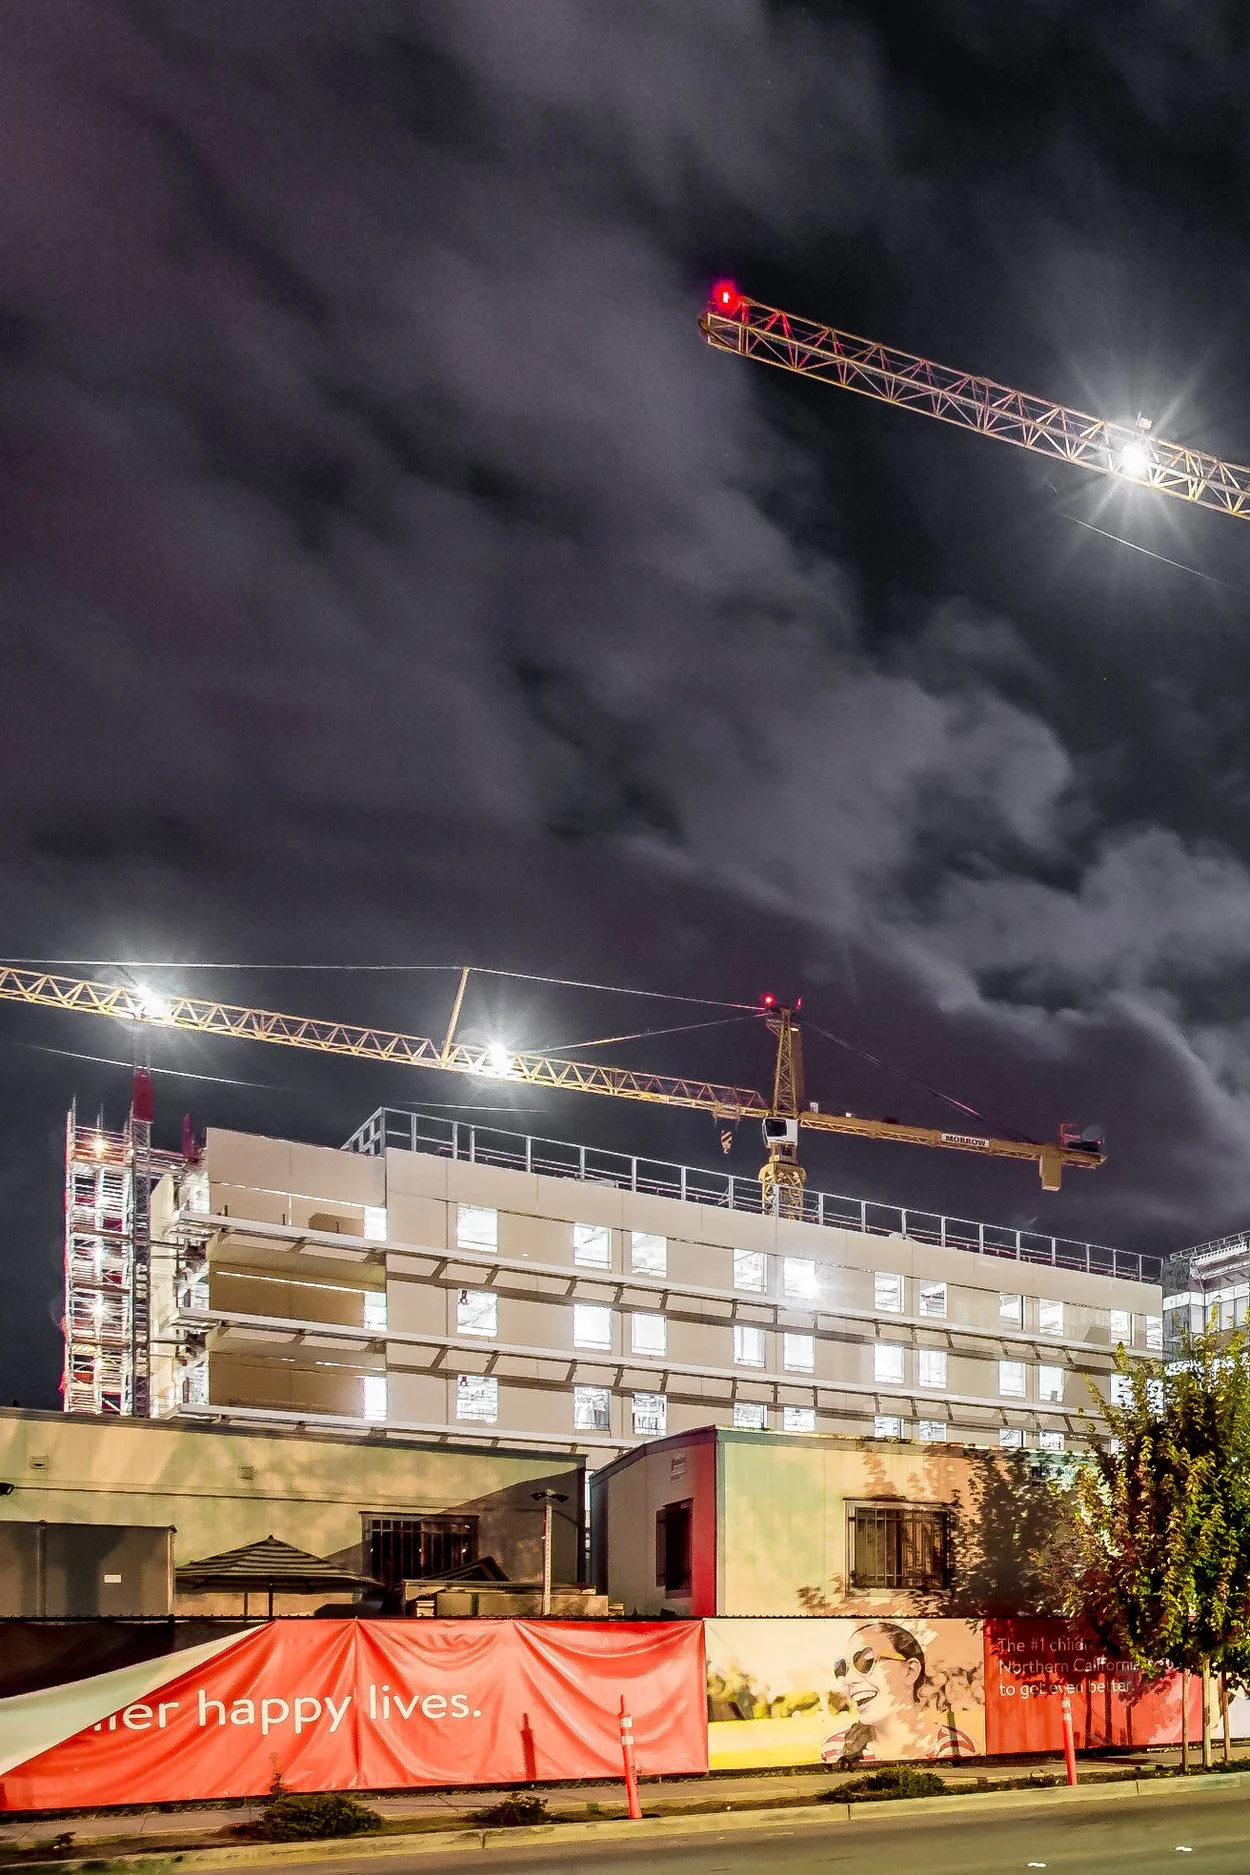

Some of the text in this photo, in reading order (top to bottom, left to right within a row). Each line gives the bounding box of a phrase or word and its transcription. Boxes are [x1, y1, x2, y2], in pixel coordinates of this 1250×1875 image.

[945, 1135, 986, 1146] MORROW
[997, 1637, 1025, 1652] The
[1031, 1636, 1045, 1652] #1
[999, 1658, 1069, 1674] Northern
[999, 1679, 1135, 1699] to get even better.
[198, 1688, 352, 1736] happy
[368, 1684, 482, 1720] lives.
